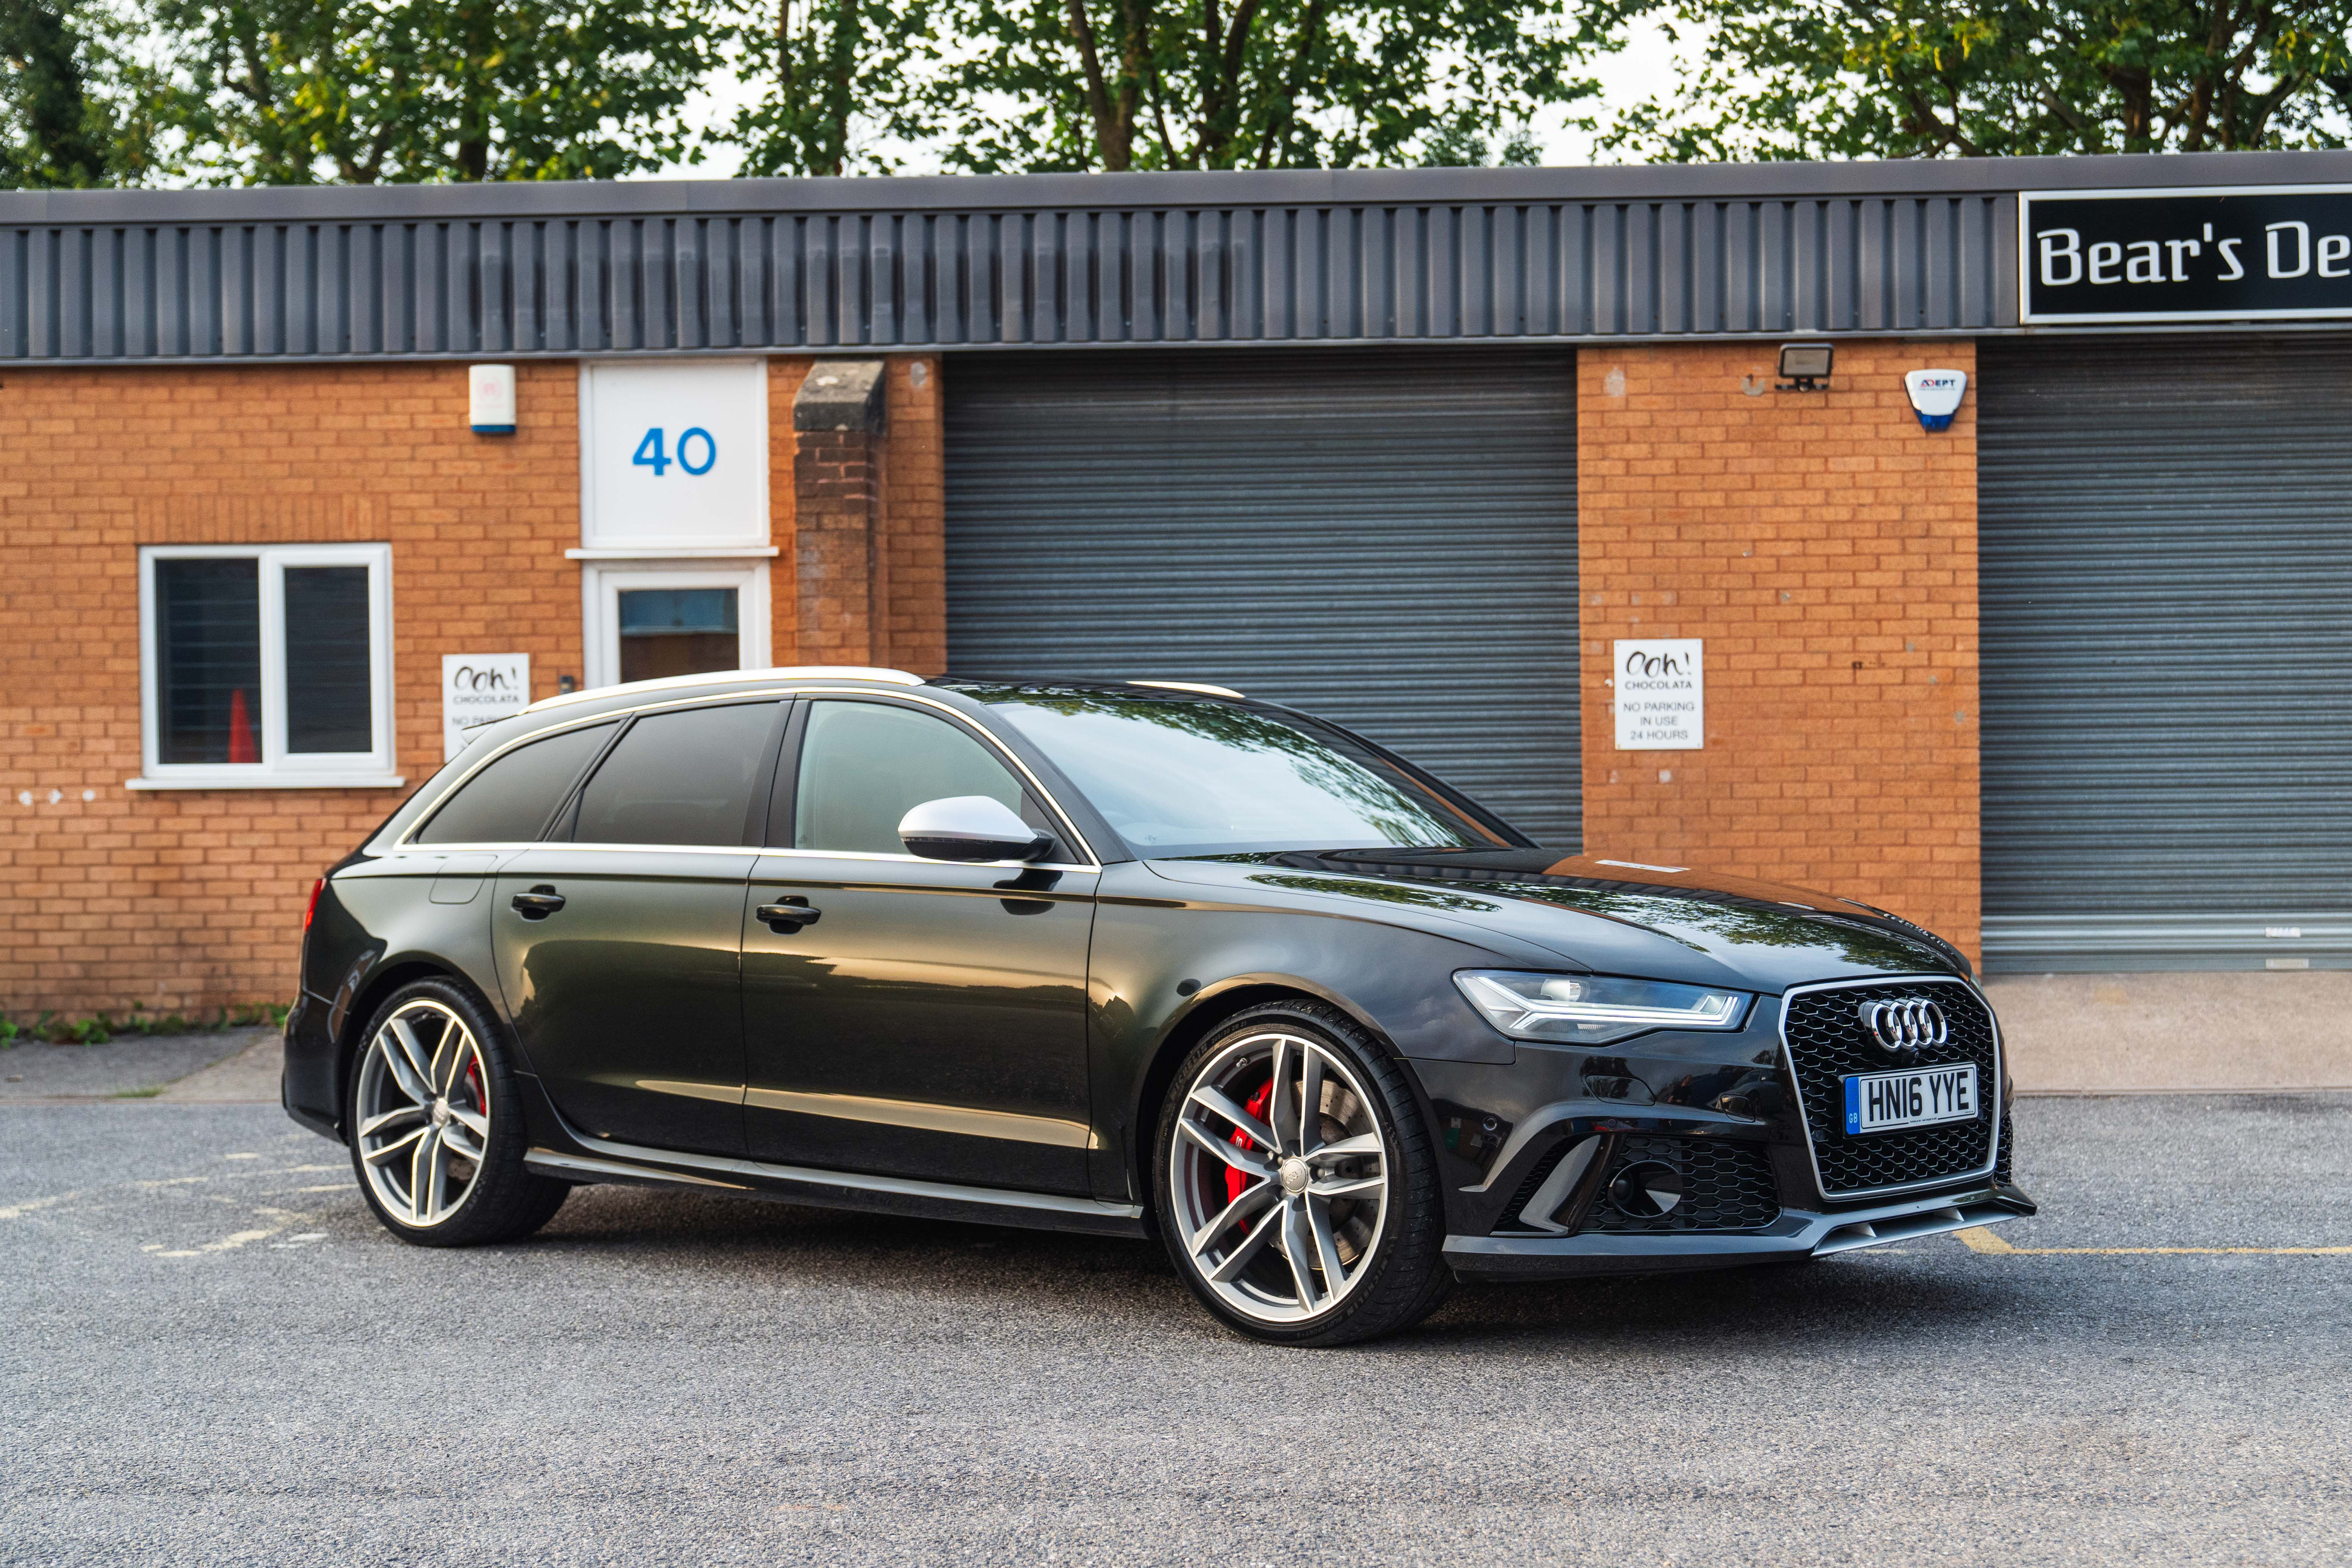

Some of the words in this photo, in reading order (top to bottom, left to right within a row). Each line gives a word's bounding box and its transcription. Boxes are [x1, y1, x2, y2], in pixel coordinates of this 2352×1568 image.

[2037, 222, 2245, 286] Bear's
[2265, 221, 2351, 279] De
[1920, 379, 1956, 387] ADEPT
[632, 427, 716, 476] 40
[1626, 651, 1692, 678] Ooh!
[454, 666, 519, 693] Ooh!
[1625, 681, 1692, 690] CHOCOLATA
[454, 696, 519, 704] CHOCOLATA
[1623, 703, 1640, 712] NO
[1644, 702, 1695, 712] PARKING
[452, 715, 469, 724] NO
[1640, 717, 1651, 726] IN
[1655, 716, 1678, 726] USE
[1630, 731, 1643, 740] 24
[1647, 730, 1688, 740] HOURS
[1868, 1077, 1923, 1122] HN16
[1929, 1071, 1970, 1114] YYE
[1848, 1112, 1858, 1124] GB
